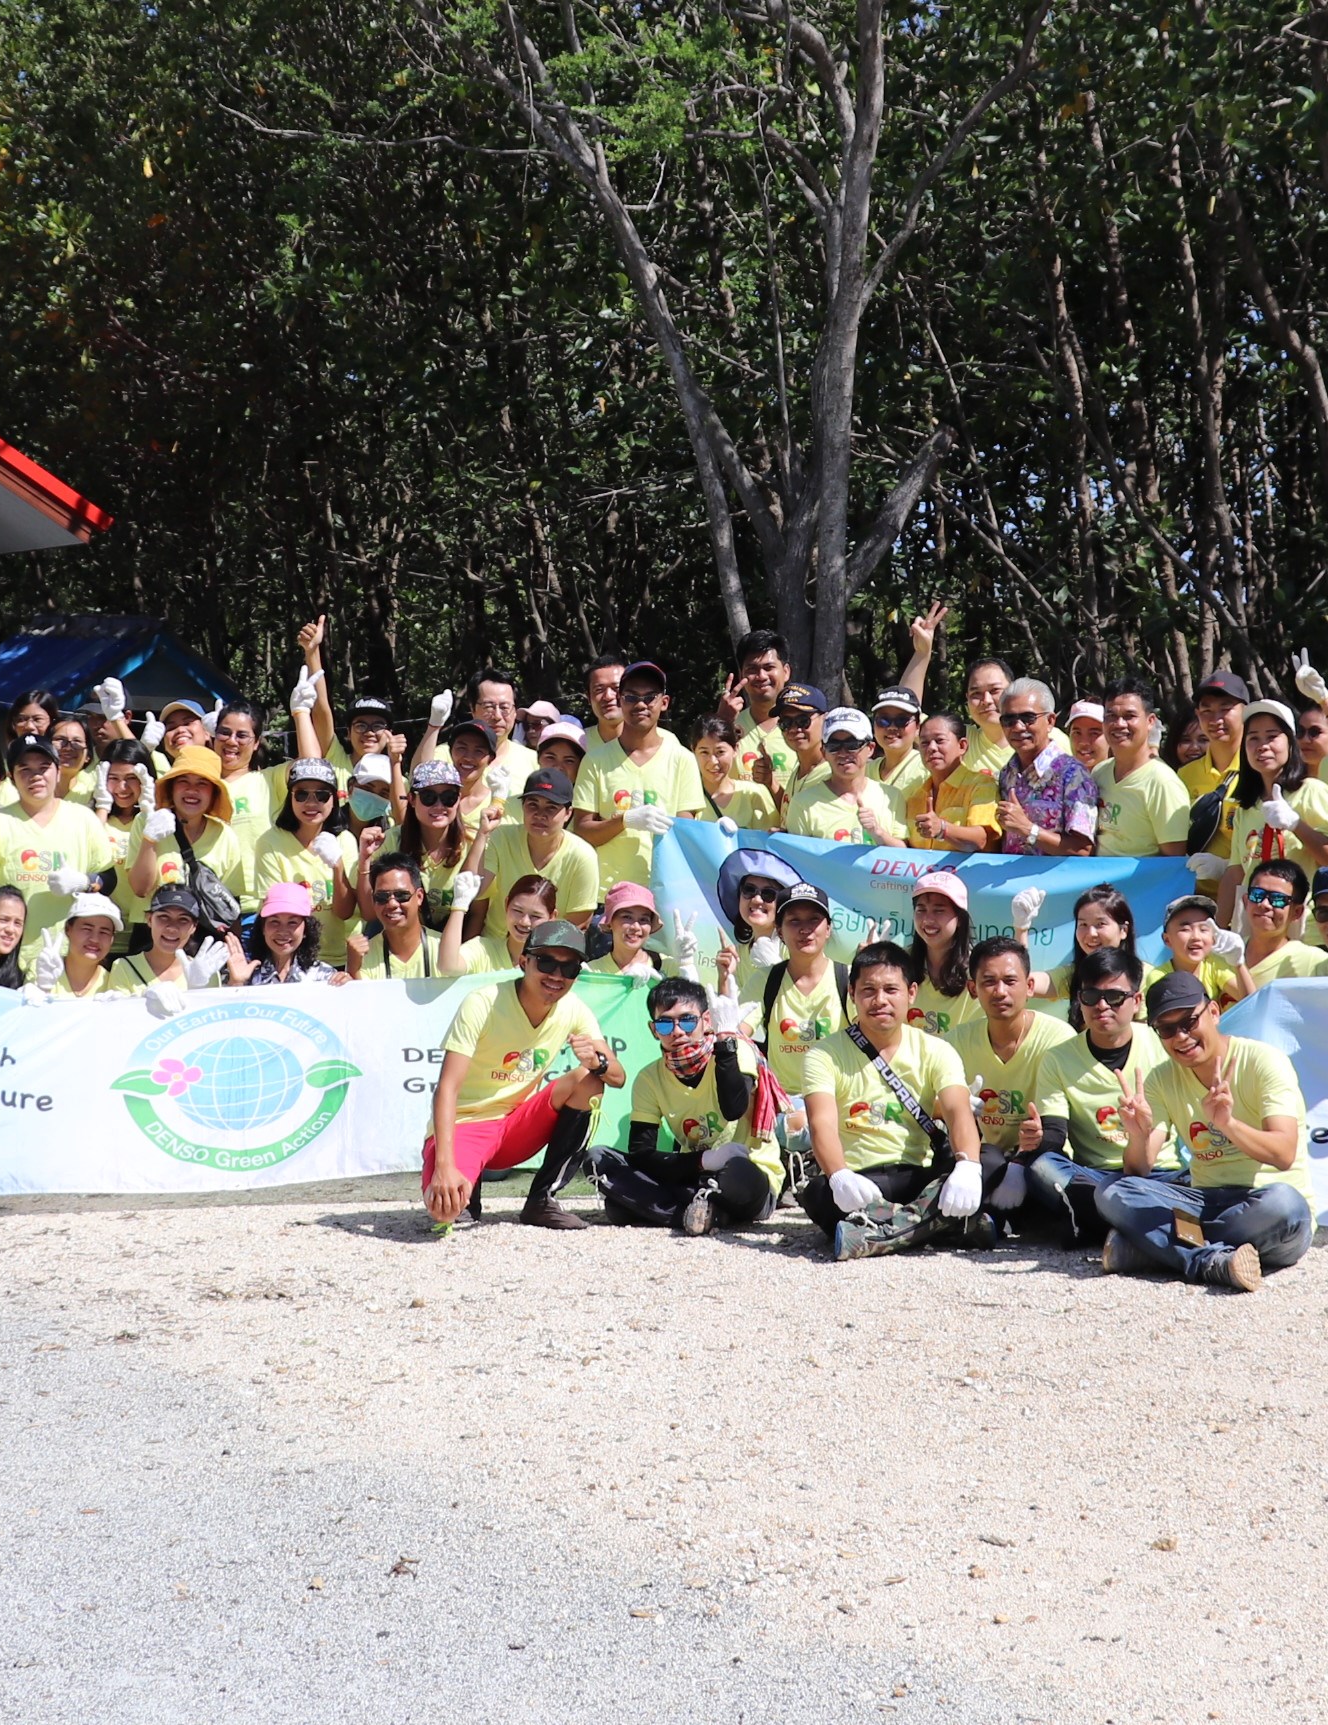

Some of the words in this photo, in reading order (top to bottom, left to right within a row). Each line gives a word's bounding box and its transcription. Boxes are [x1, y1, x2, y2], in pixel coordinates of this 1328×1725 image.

[742, 752, 788, 772] CR
[870, 880, 909, 893] Crafting
[145, 1028, 176, 1052] Our
[175, 1009, 229, 1030] Earth
[244, 1005, 281, 1019] Our
[280, 1010, 328, 1046] Future
[779, 1017, 832, 1042] CSR
[907, 1007, 951, 1034] CSR
[502, 1048, 551, 1072] CSR
[490, 1070, 525, 1082] DENSO
[872, 1056, 937, 1133] SUPREME
[979, 1088, 1027, 1115] CSR
[849, 1101, 904, 1126] CSR
[144, 1120, 210, 1161] DENSO
[215, 1150, 276, 1169] Green
[280, 1110, 333, 1157] Action
[1189, 1121, 1232, 1149] CS
